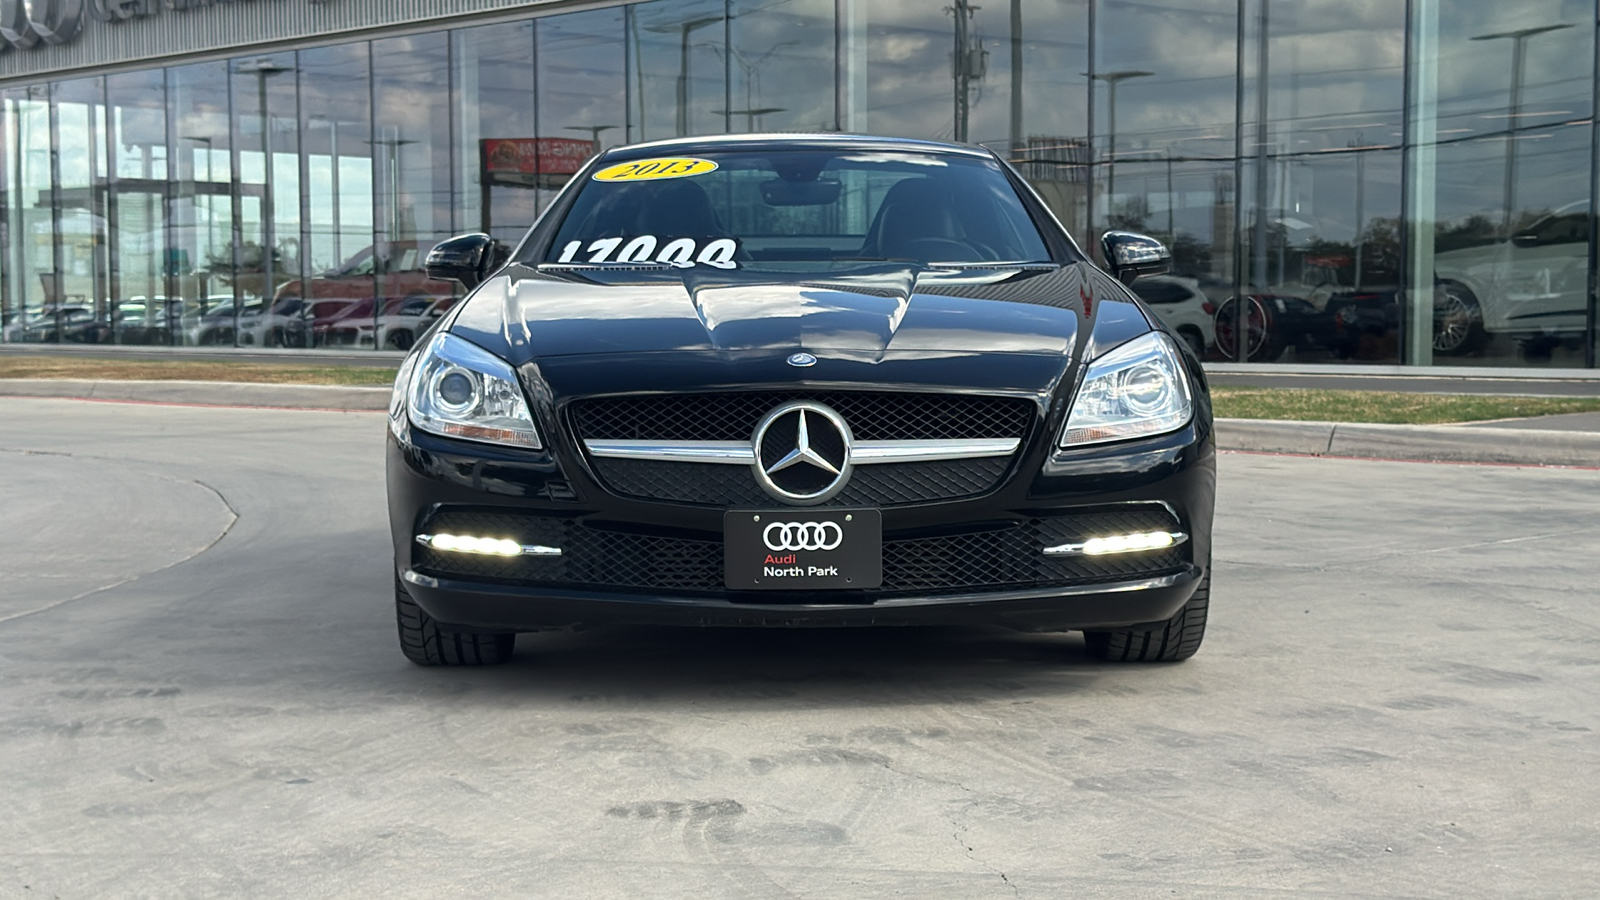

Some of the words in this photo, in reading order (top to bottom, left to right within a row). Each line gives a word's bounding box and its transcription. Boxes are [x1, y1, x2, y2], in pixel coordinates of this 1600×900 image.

[611, 160, 701, 179] 2013
[764, 554, 796, 564] Audi
[763, 566, 804, 577] North
[808, 565, 838, 576] Park
